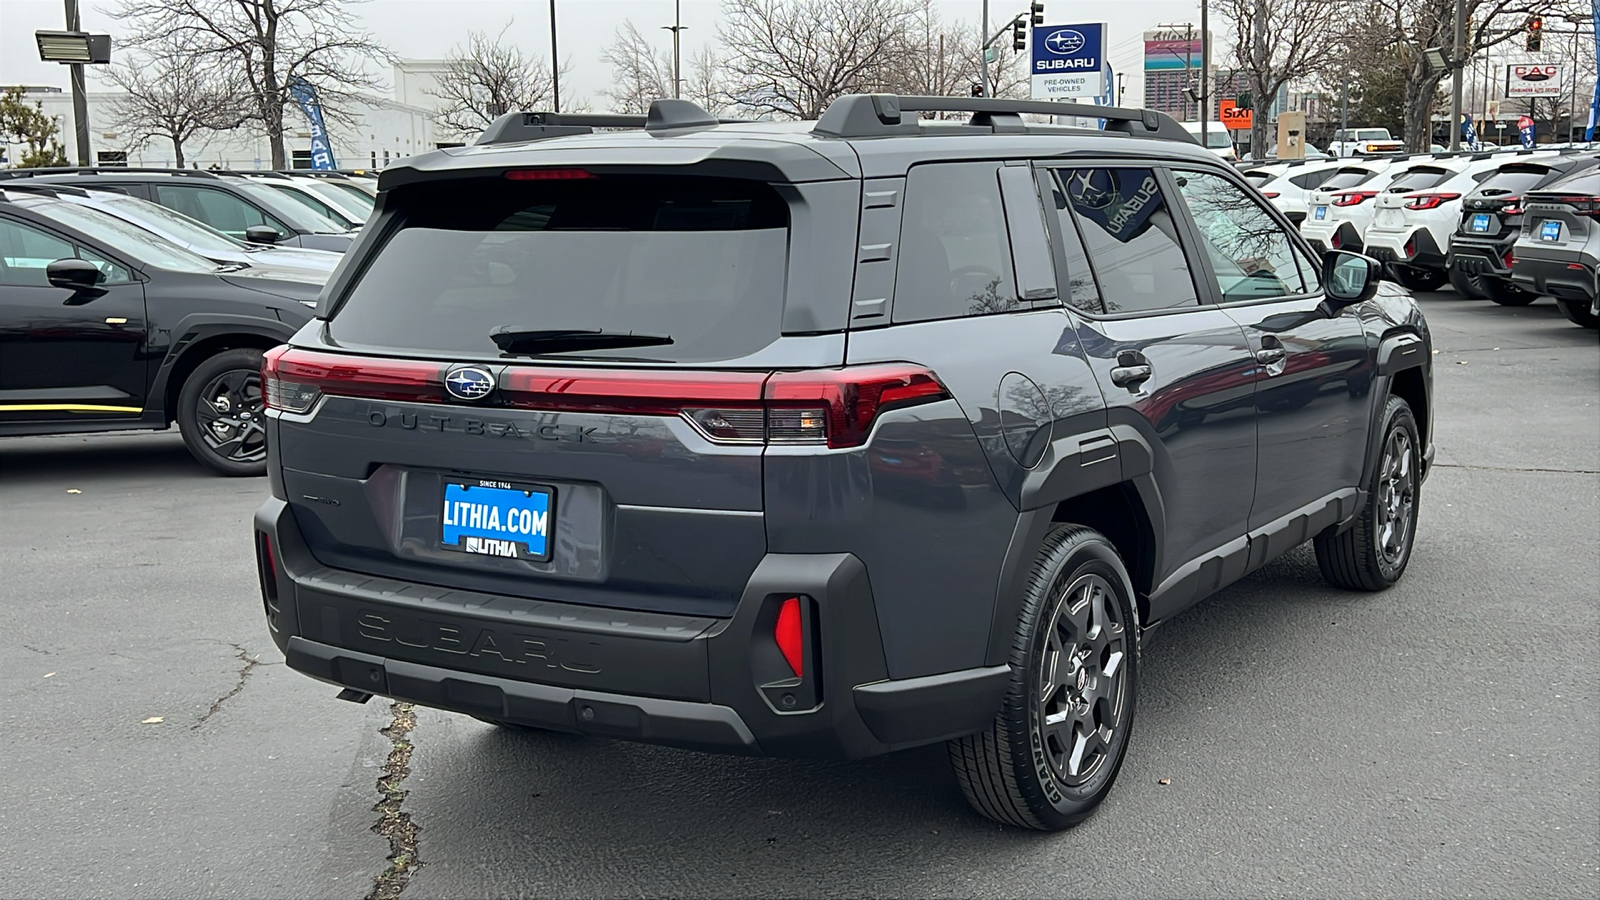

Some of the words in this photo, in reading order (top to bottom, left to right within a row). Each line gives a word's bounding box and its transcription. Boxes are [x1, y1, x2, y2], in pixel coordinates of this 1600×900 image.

[1153, 31, 1198, 41] Atlants
[1036, 58, 1095, 70] SUBARU
[1515, 66, 1557, 75] CAC
[1044, 78, 1086, 86] PRE-OWNED
[368, 410, 598, 444] OUTBACK
[479, 480, 497, 489] SINCE
[443, 500, 548, 537] LITHIA.COM
[478, 538, 518, 558] LITHIA
[358, 608, 603, 674] SUBARU
